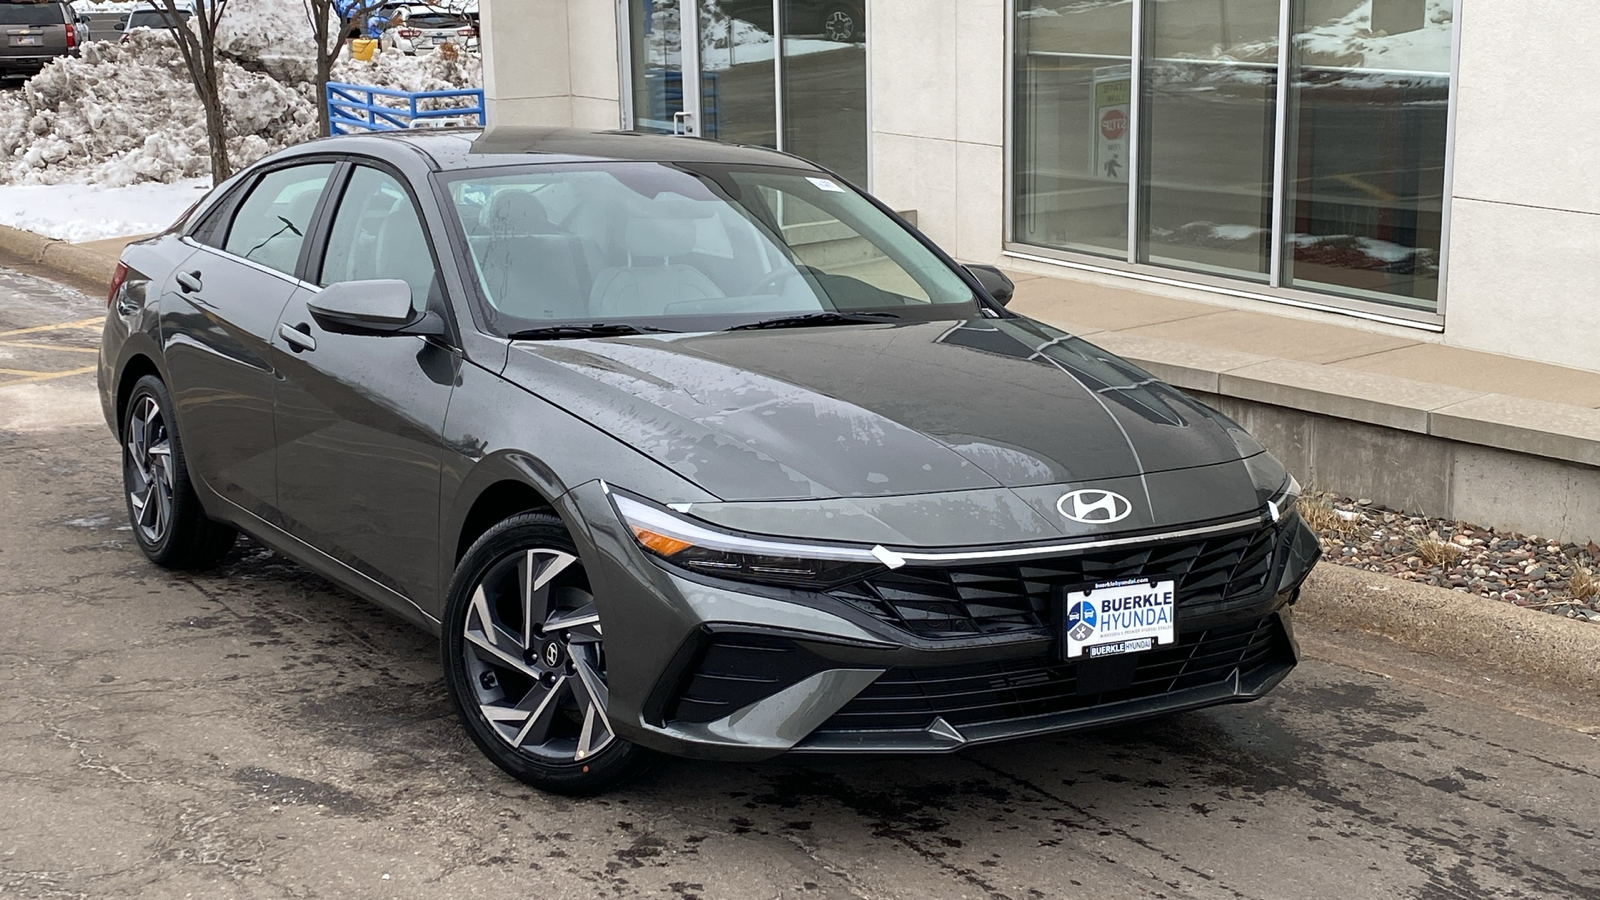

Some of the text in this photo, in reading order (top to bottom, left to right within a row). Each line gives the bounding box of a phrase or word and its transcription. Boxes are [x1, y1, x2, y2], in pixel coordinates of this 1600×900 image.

[1095, 578, 1149, 589] buerklehyundai.com
[1101, 591, 1172, 613] BUERKLE
[1100, 606, 1172, 632] HYUNDAI
[1091, 639, 1151, 656] BUERKLE HYUNDAI
